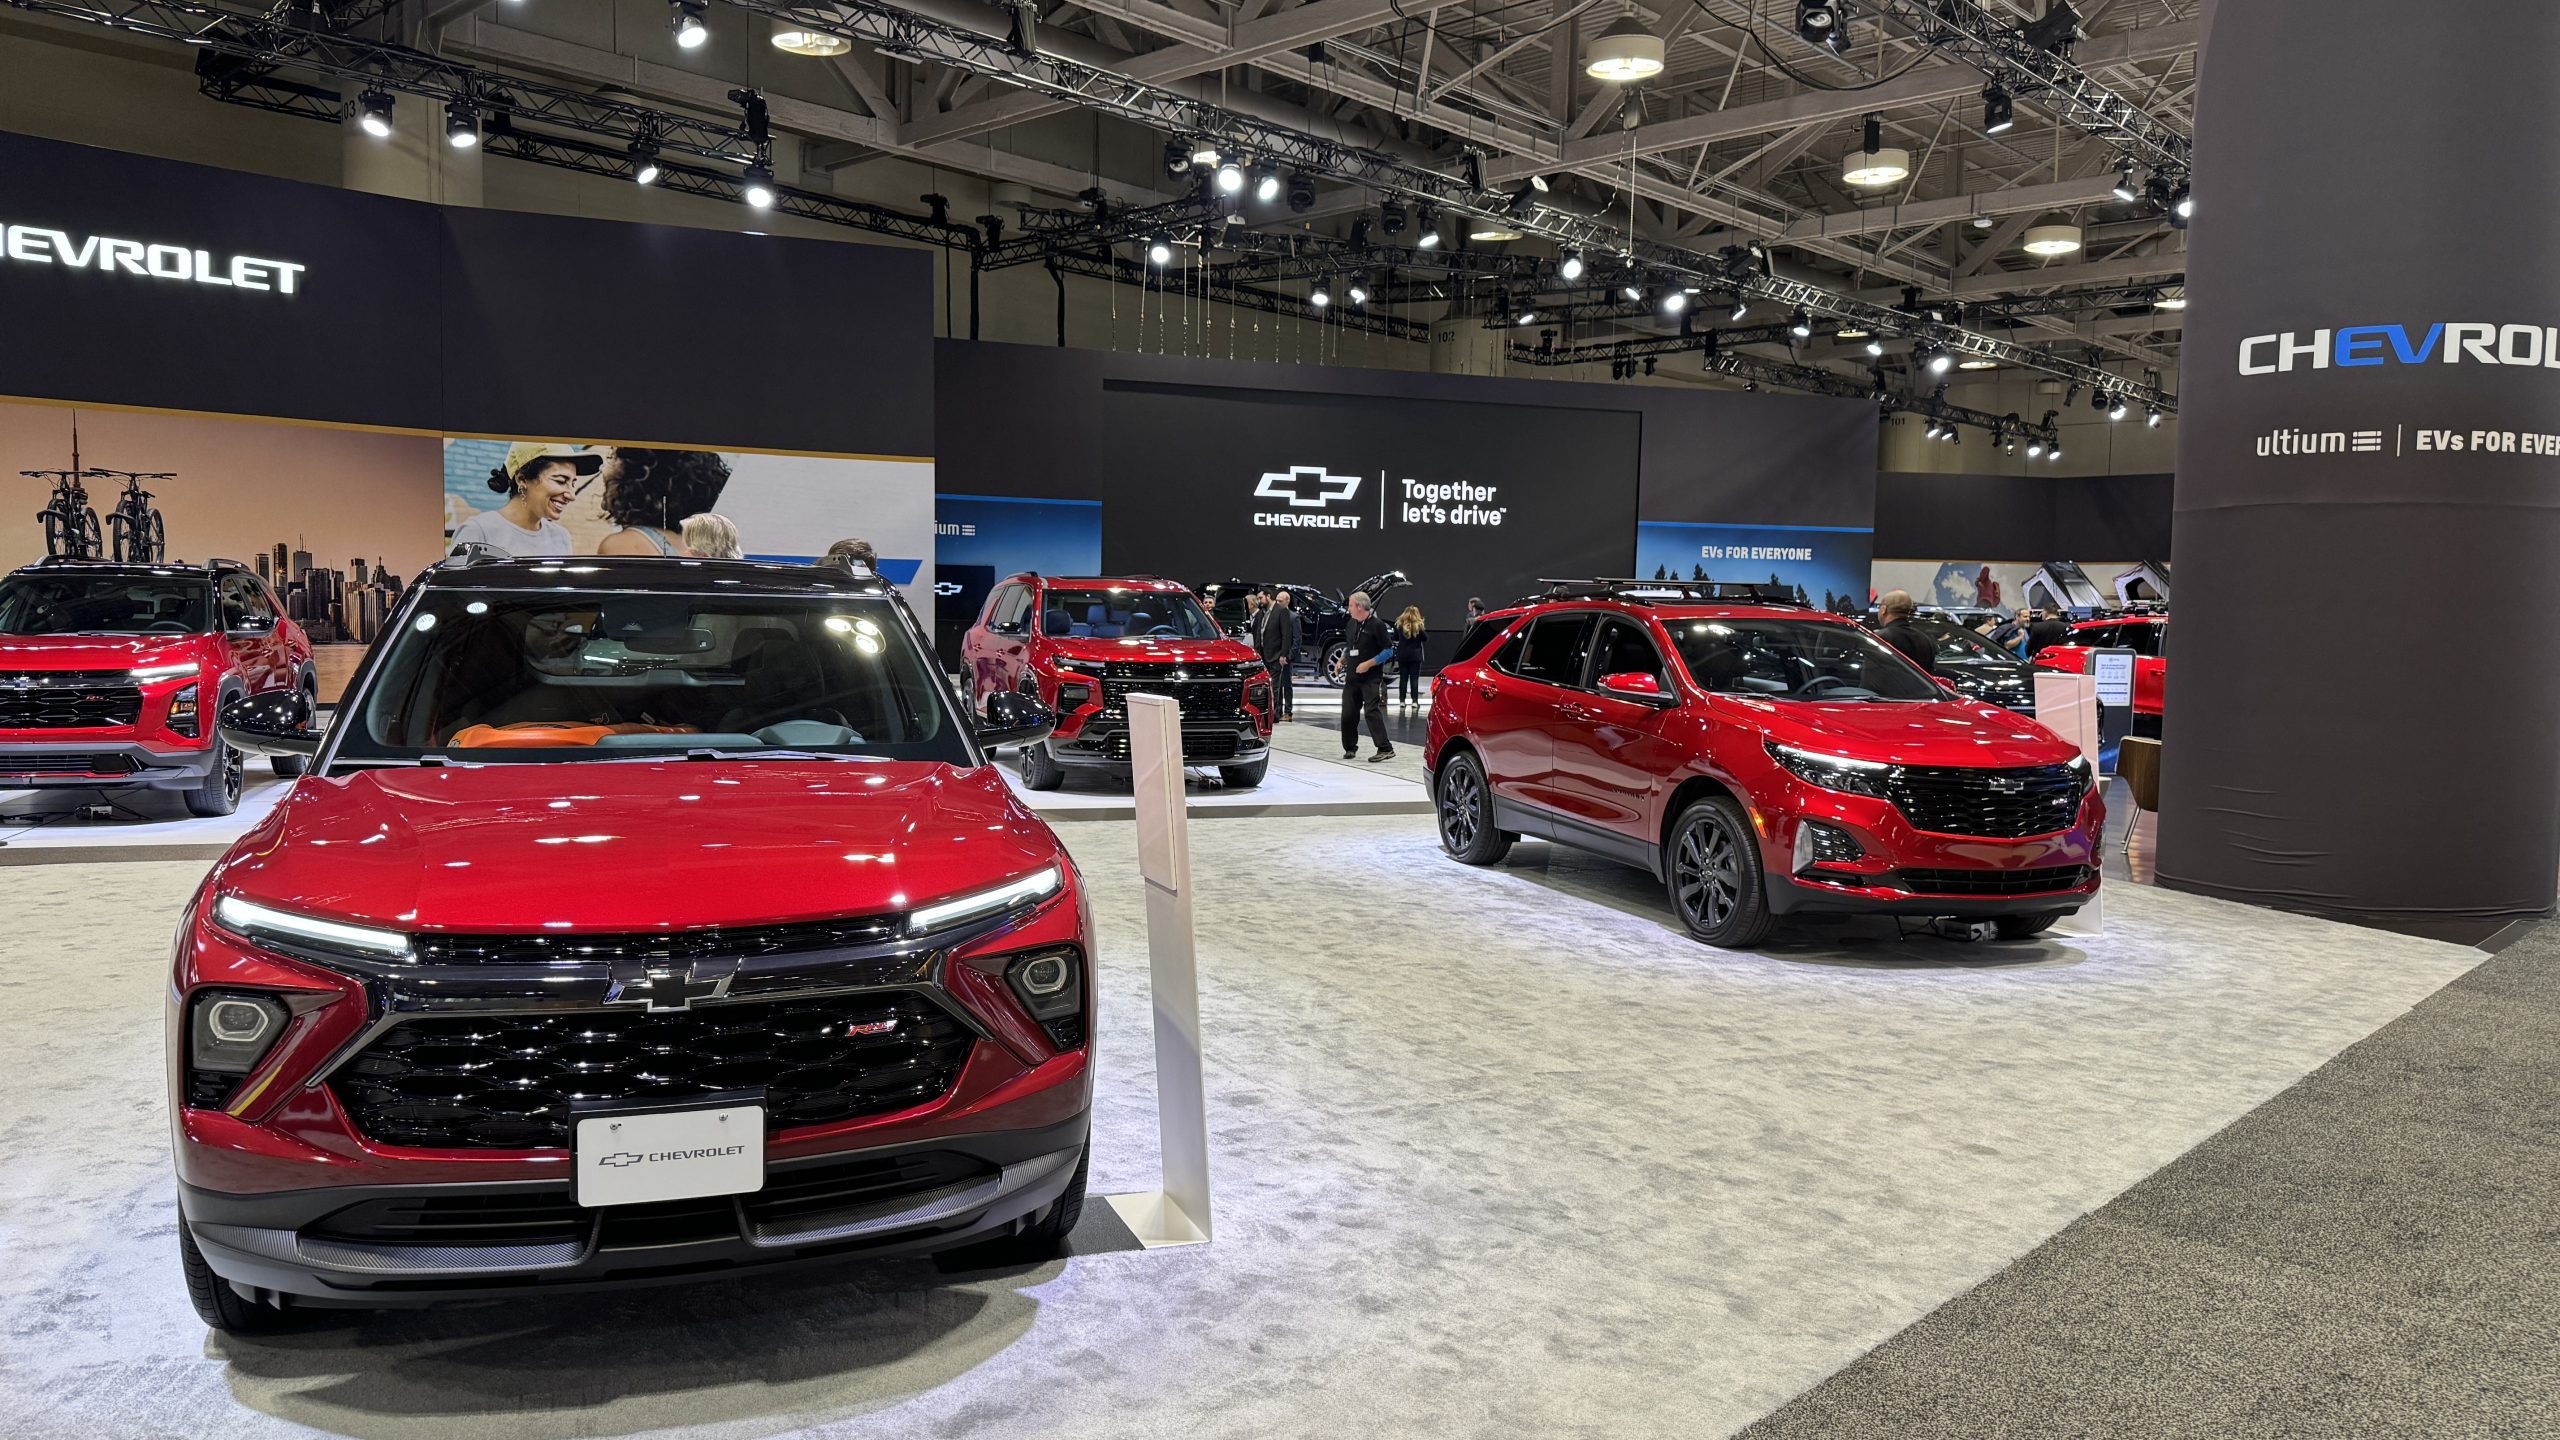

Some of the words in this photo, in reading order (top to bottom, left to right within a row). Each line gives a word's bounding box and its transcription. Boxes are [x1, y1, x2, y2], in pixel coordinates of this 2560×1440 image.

[0, 223, 305, 293] EVROLET
[2238, 322, 2560, 376] CHEVROL
[2256, 428, 2346, 457] ultium
[2416, 430, 2464, 451] EVs
[2470, 430, 2516, 452] FOR
[1401, 479, 1497, 503] Together
[1253, 512, 1361, 529] CHEVROLET
[1402, 502, 1446, 524] let's
[1701, 545, 1723, 559] EVs
[1725, 546, 1749, 559] FOR
[1751, 547, 1813, 561] EVERYONE
[649, 1145, 745, 1162] CHEVROLET
